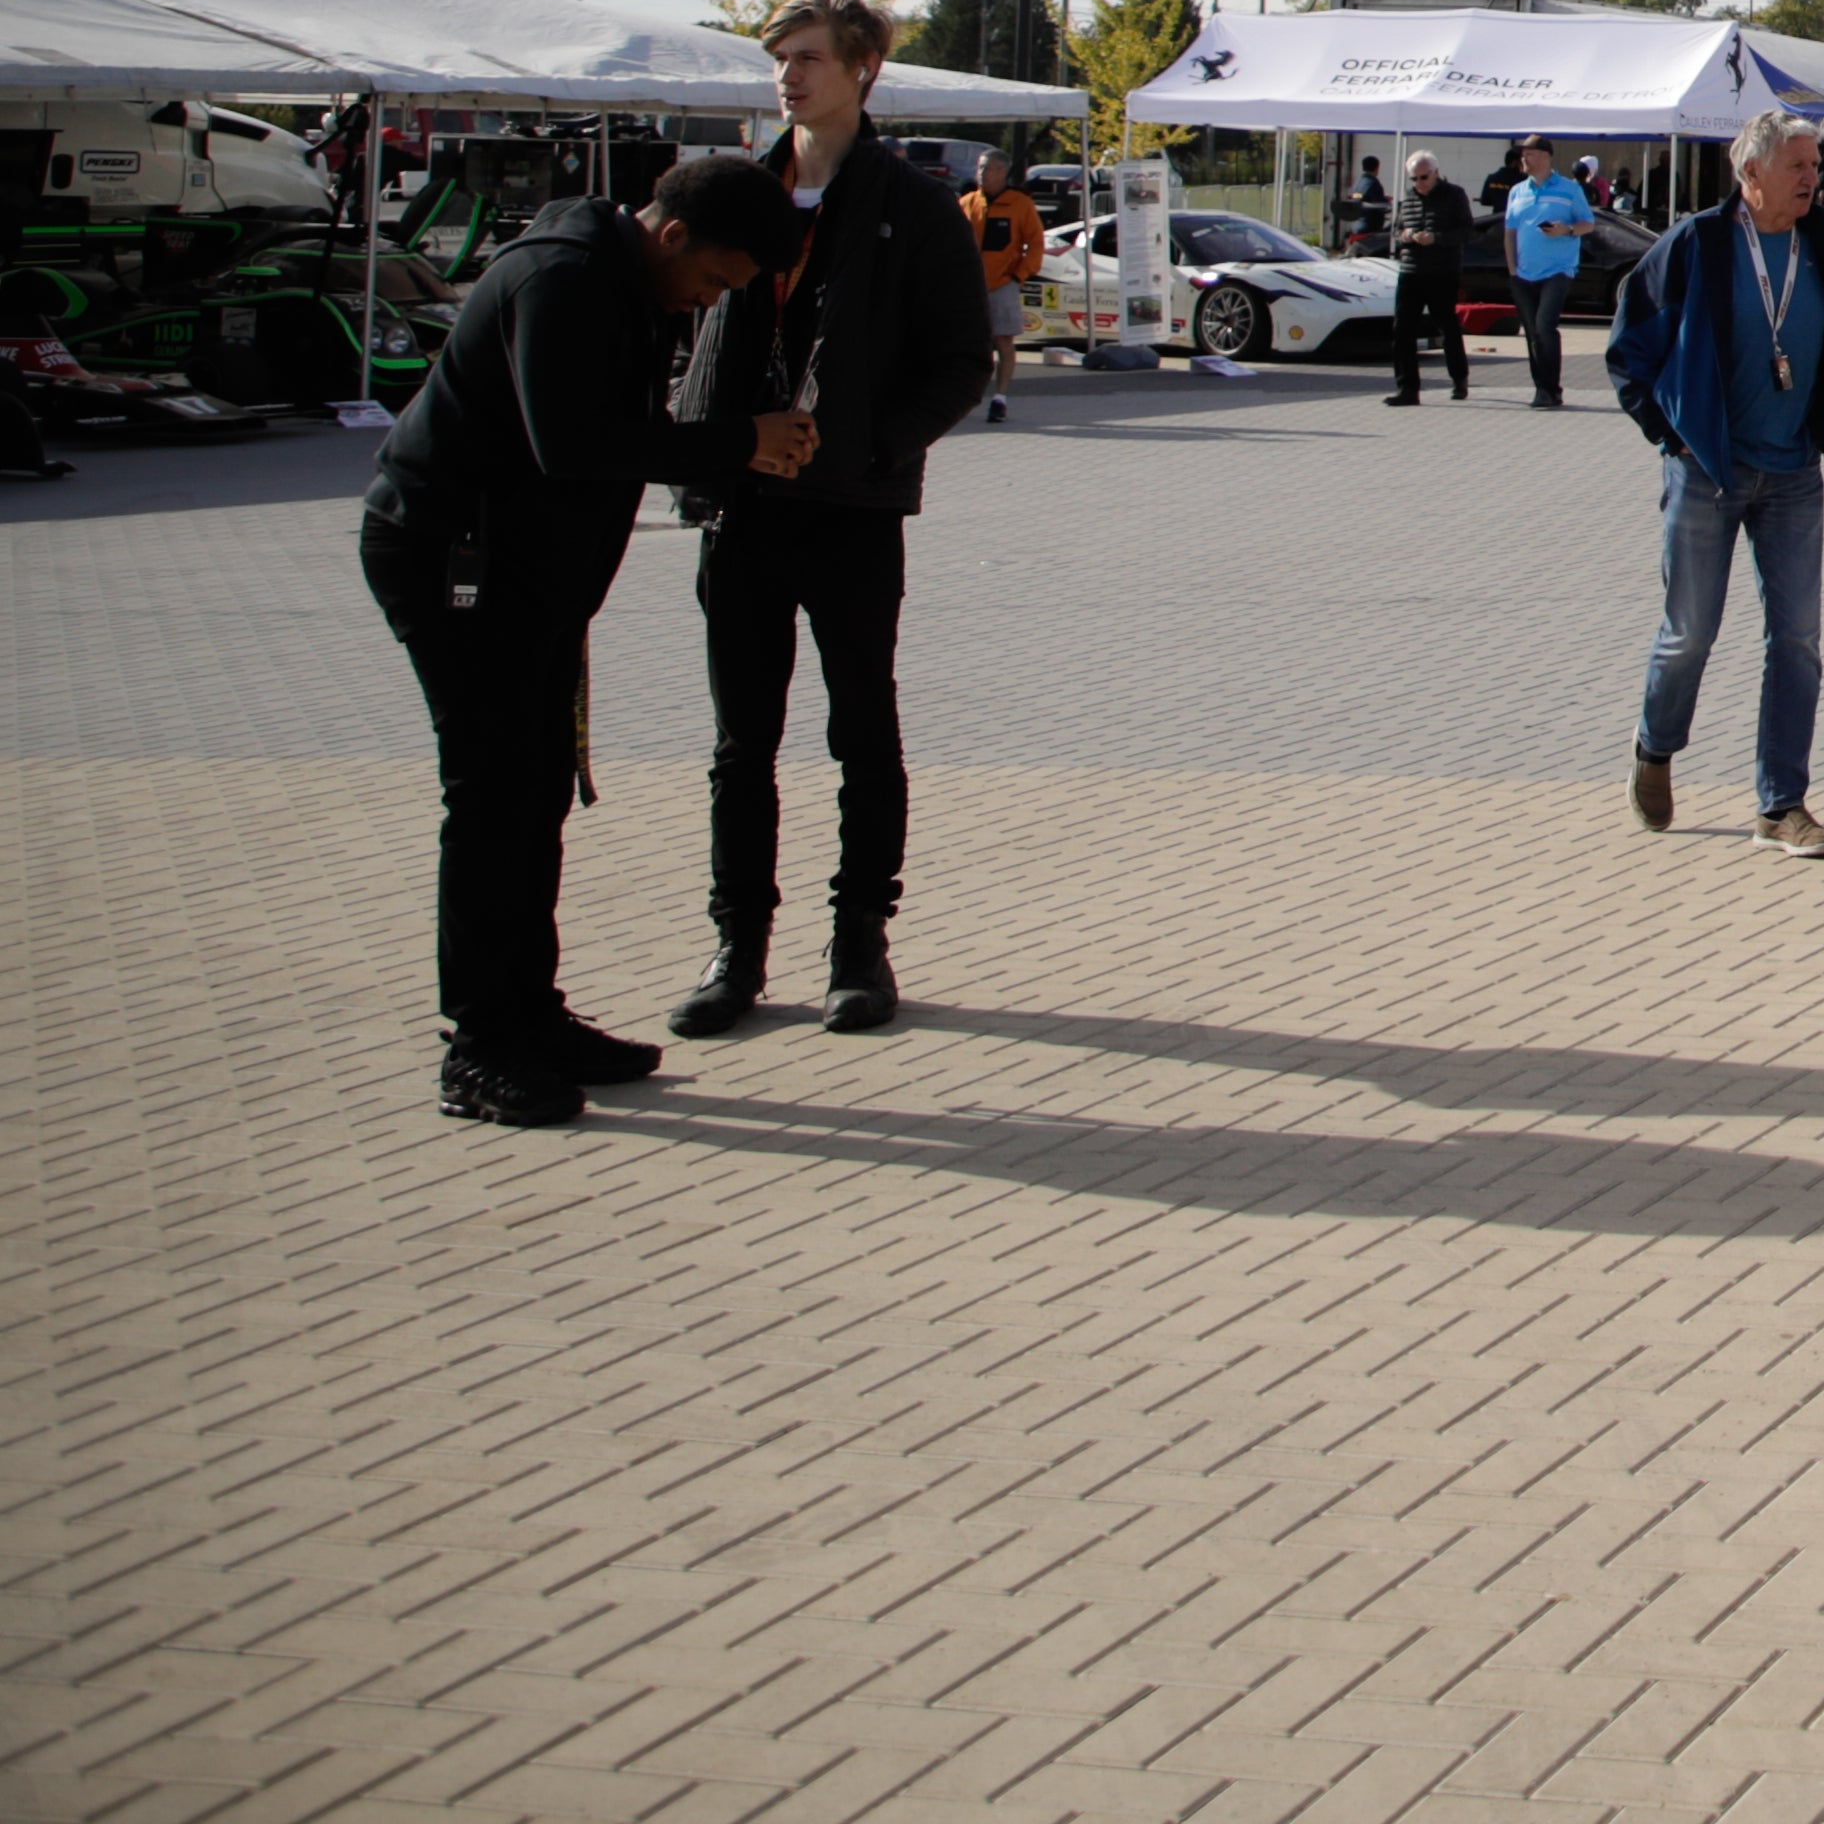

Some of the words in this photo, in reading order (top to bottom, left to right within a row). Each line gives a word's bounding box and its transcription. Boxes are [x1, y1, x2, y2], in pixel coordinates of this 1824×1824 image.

[1341, 55, 1455, 71] OFFICIAL
[1330, 70, 1441, 85] FERRARI
[1445, 71, 1553, 88] DEALER
[1428, 80, 1535, 98] FERRARI
[1542, 90, 1577, 100] OF
[1713, 117, 1746, 130] FERRAR
